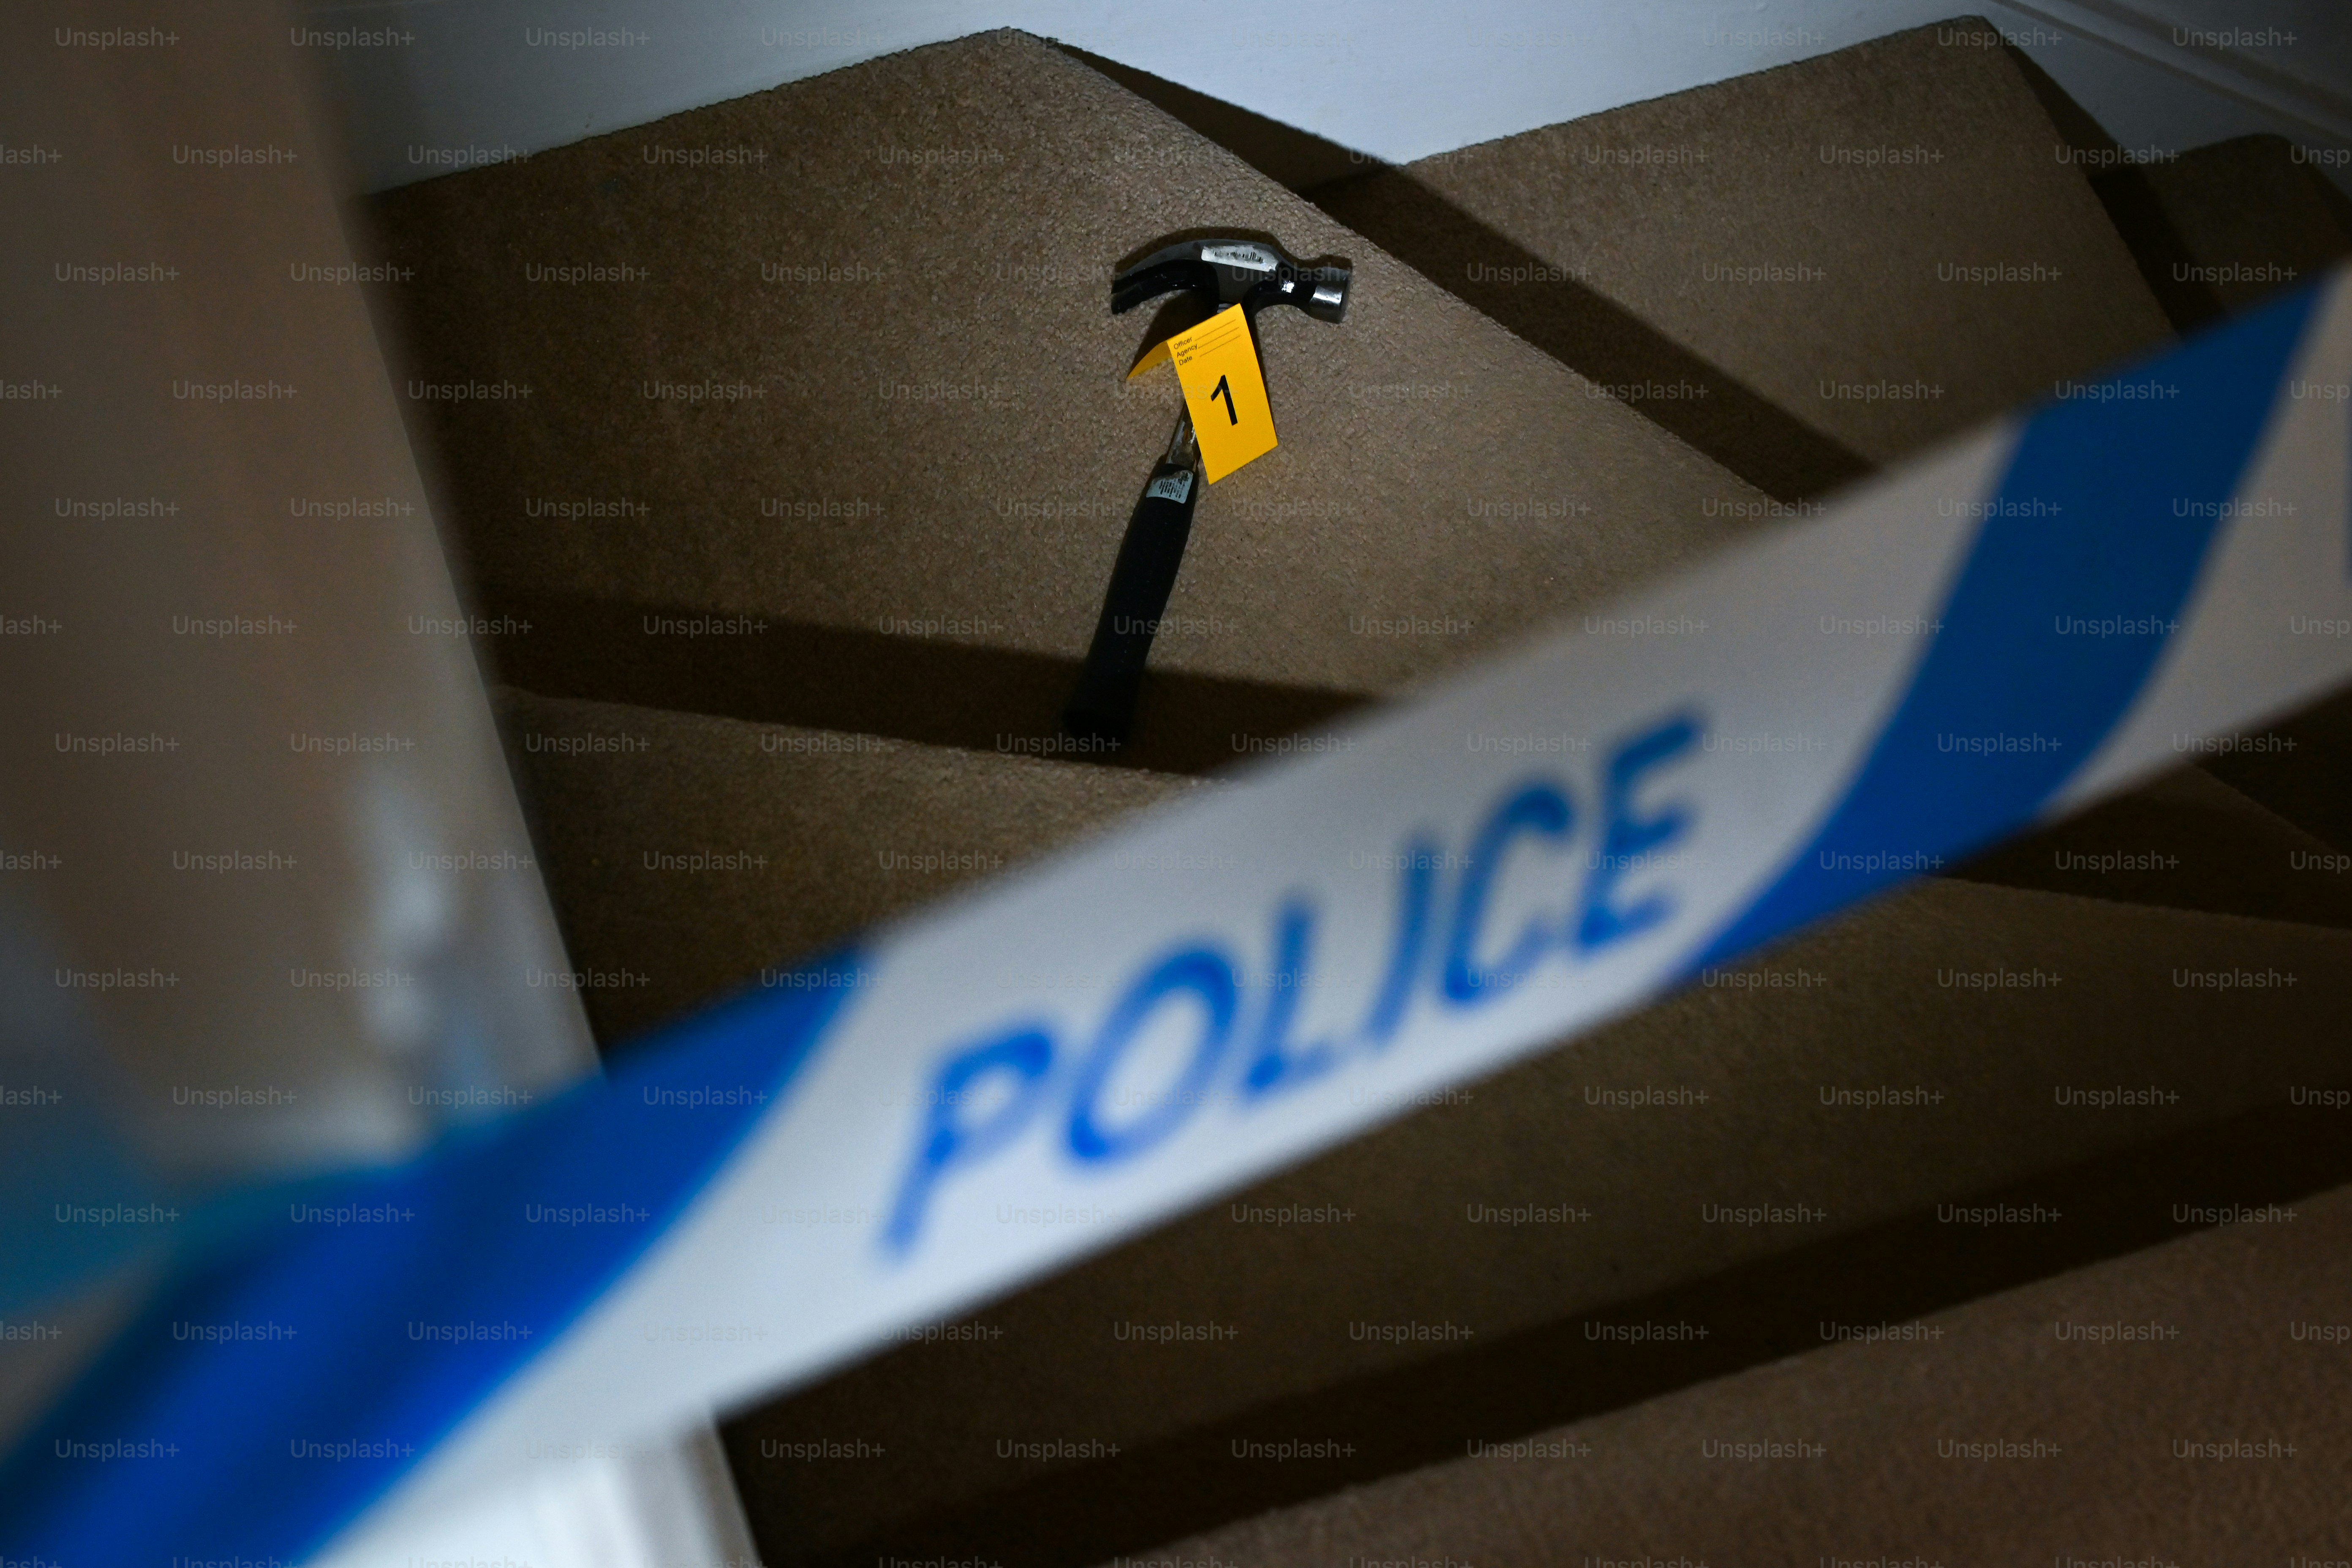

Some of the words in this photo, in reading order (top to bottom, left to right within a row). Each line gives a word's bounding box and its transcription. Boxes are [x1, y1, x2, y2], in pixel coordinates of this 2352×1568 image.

[1173, 337, 1192, 349] Officer
[1177, 343, 1197, 358] Agency
[1179, 356, 1192, 365] Date
[1210, 374, 1238, 426] 1
[874, 702, 1709, 1263] POLICE
